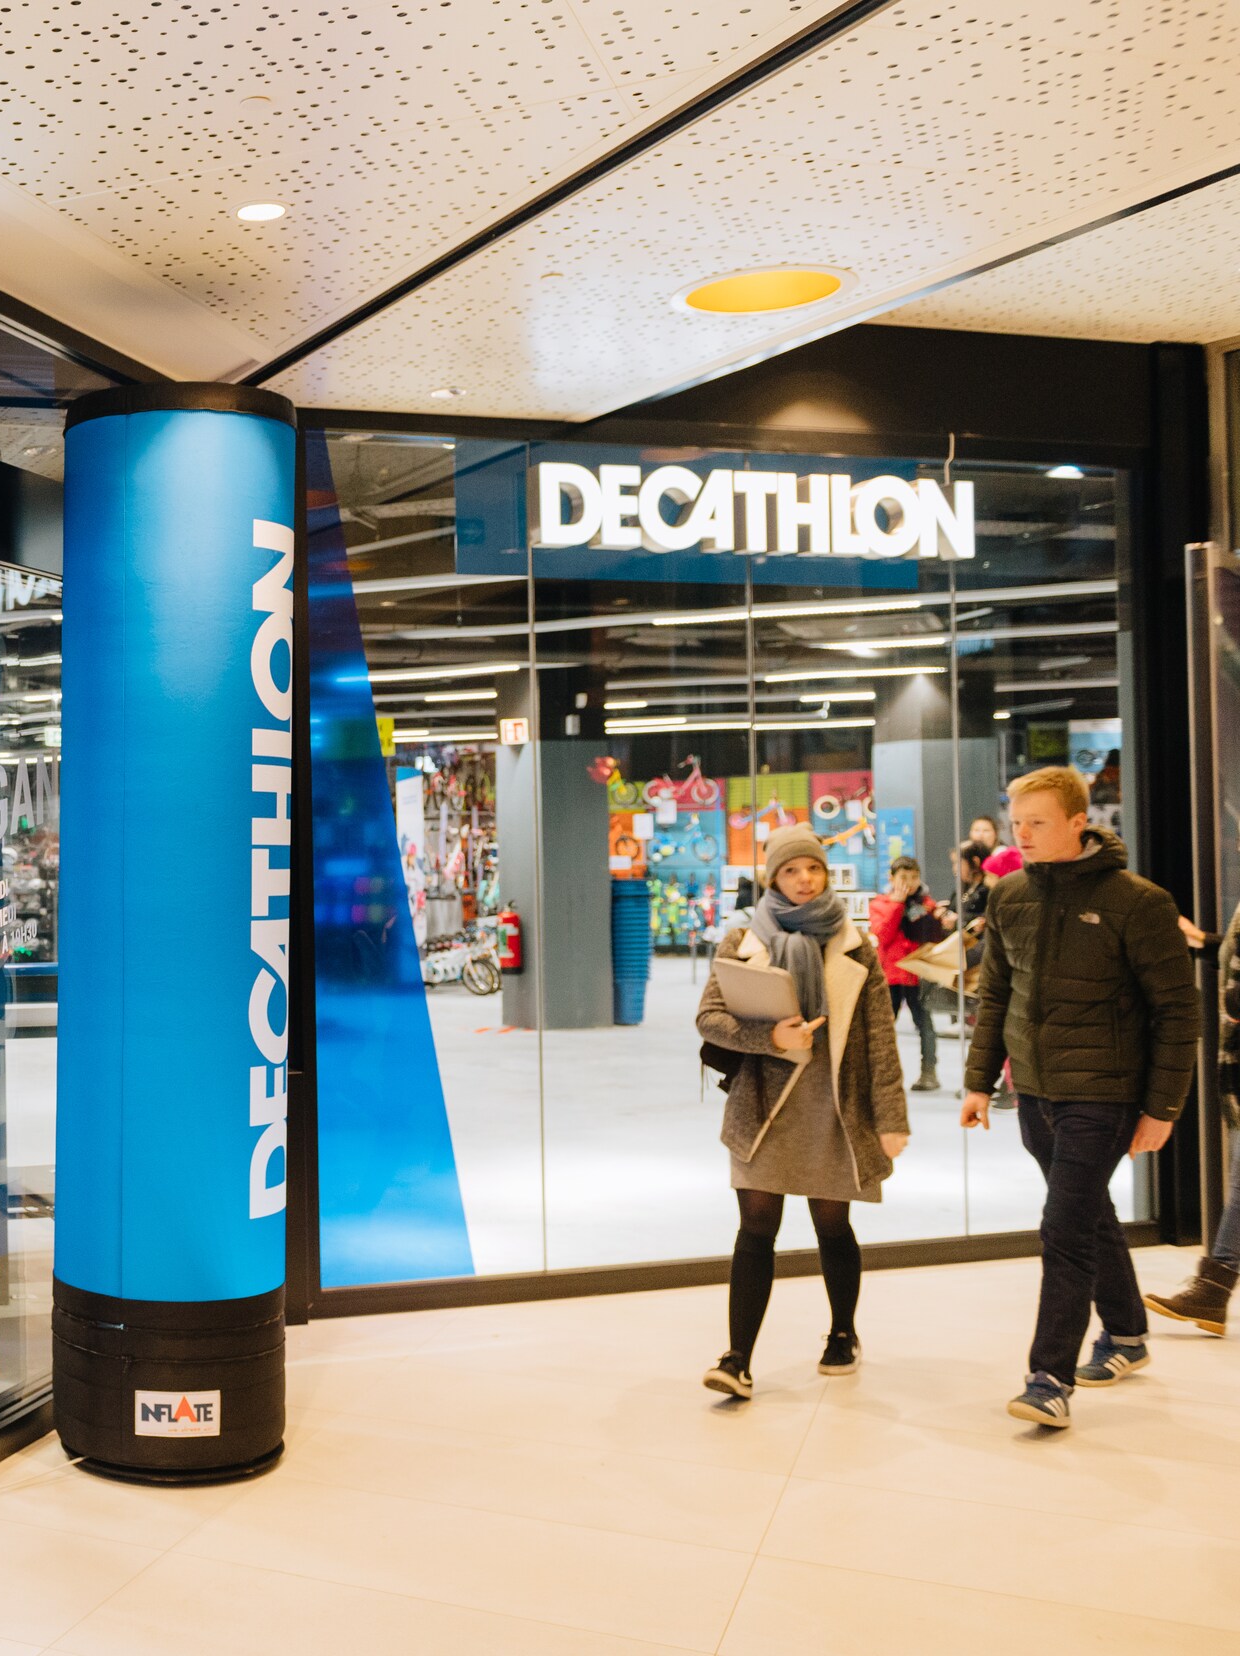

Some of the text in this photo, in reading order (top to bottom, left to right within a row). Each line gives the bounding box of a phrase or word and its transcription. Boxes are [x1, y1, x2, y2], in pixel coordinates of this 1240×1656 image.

[538, 462, 977, 560] DECATHLON
[248, 519, 295, 1218] DECATHLON
[2, 930, 9, 954] À
[10, 917, 38, 945] 19H30
